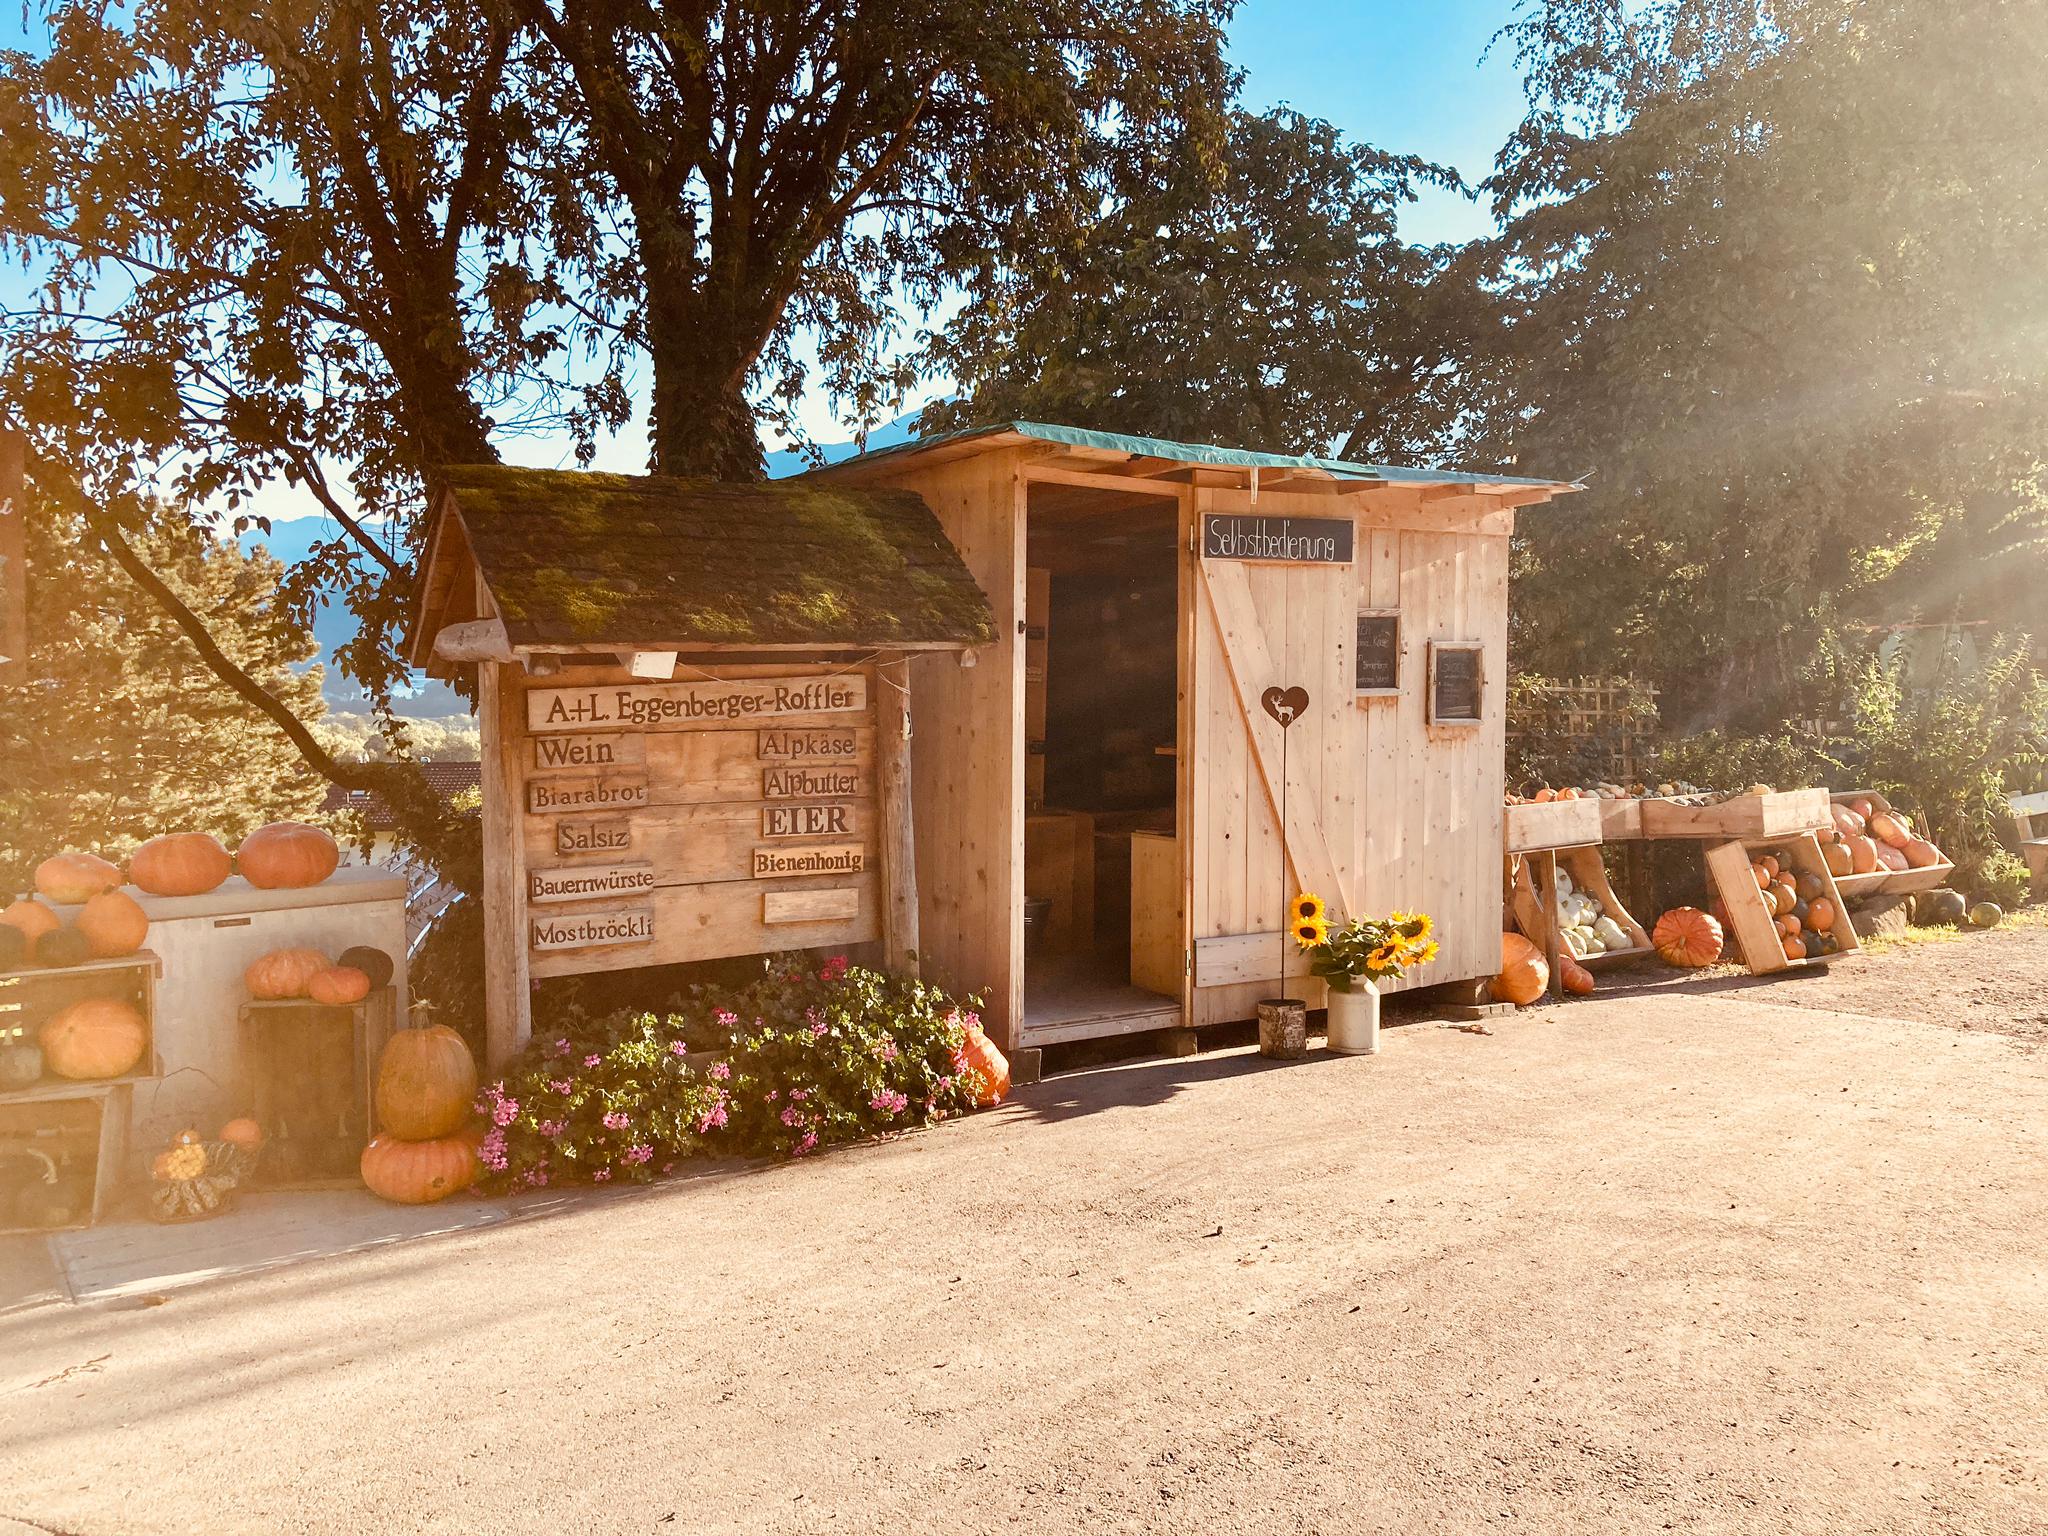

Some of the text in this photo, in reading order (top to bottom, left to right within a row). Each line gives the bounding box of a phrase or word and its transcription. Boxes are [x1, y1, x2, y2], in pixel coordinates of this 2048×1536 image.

[1209, 519, 1335, 561] Selbstbedienung
[615, 683, 854, 725] Eggenberger-Roffler
[538, 737, 614, 766] Wein
[762, 732, 855, 760] Alpkäse
[536, 783, 644, 807] Biarabrot
[766, 770, 859, 796] Alpbutter
[765, 806, 849, 835] EIER
[560, 823, 628, 849] Salsiz
[755, 850, 862, 873] Bienenhonig
[533, 871, 654, 897] Bauernwürste
[534, 915, 654, 946] Mostbröckli
